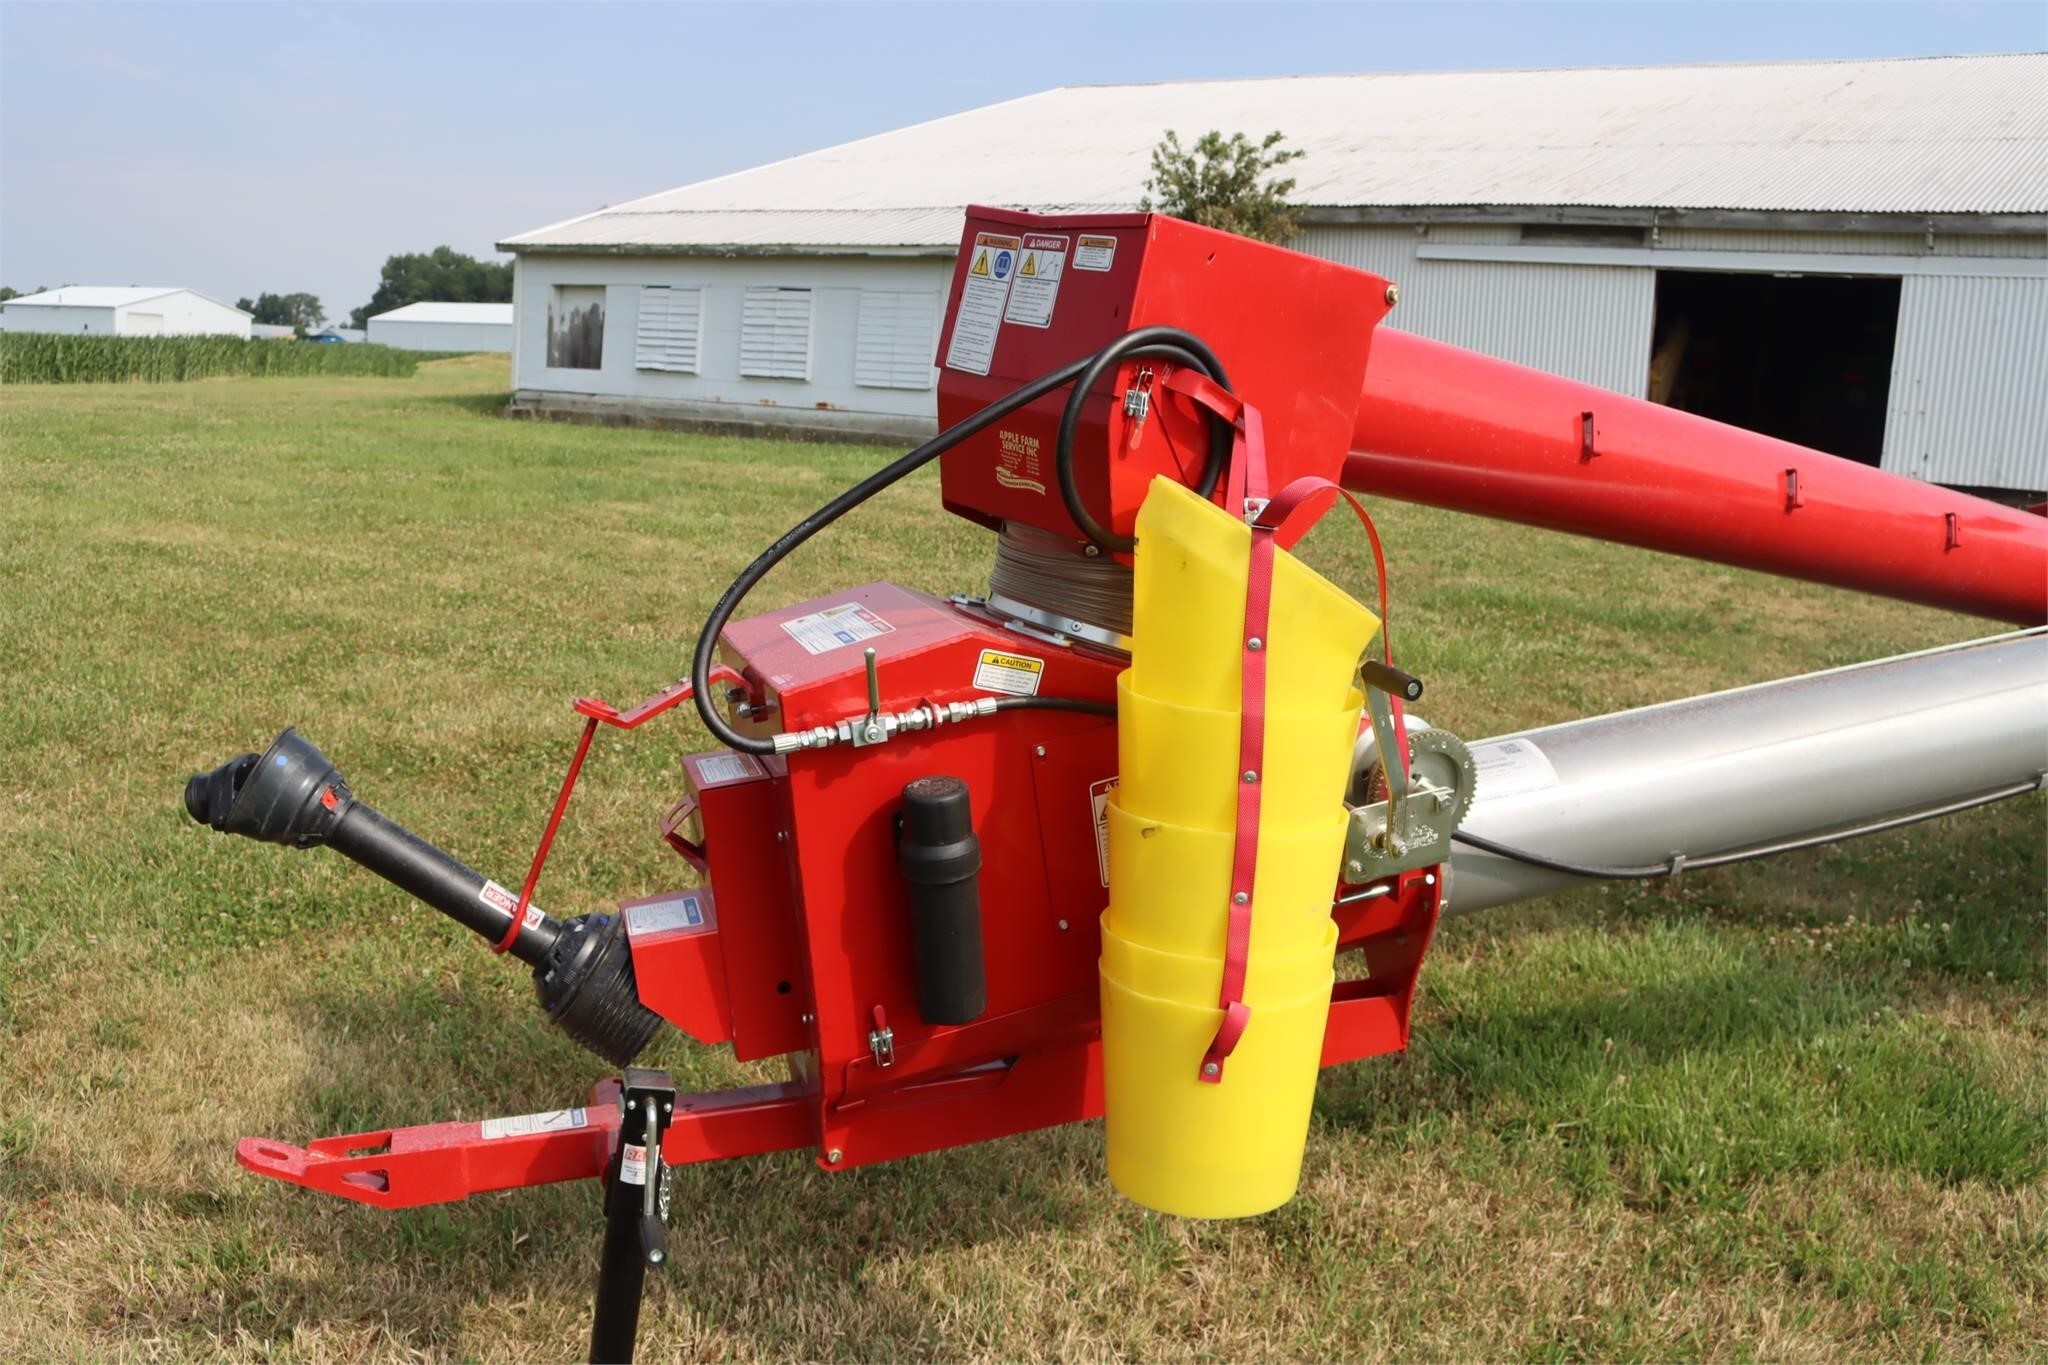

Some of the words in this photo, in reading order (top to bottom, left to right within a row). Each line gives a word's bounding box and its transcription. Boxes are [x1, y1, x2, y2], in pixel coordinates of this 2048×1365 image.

[1035, 239, 1062, 249] DANGER
[999, 430, 1020, 443] APPLE
[1020, 435, 1040, 449] FARM
[1002, 440, 1025, 454] SERVICE
[1026, 447, 1038, 457] INC
[1000, 657, 1032, 670] CAUTION
[485, 887, 520, 914] ANGER
